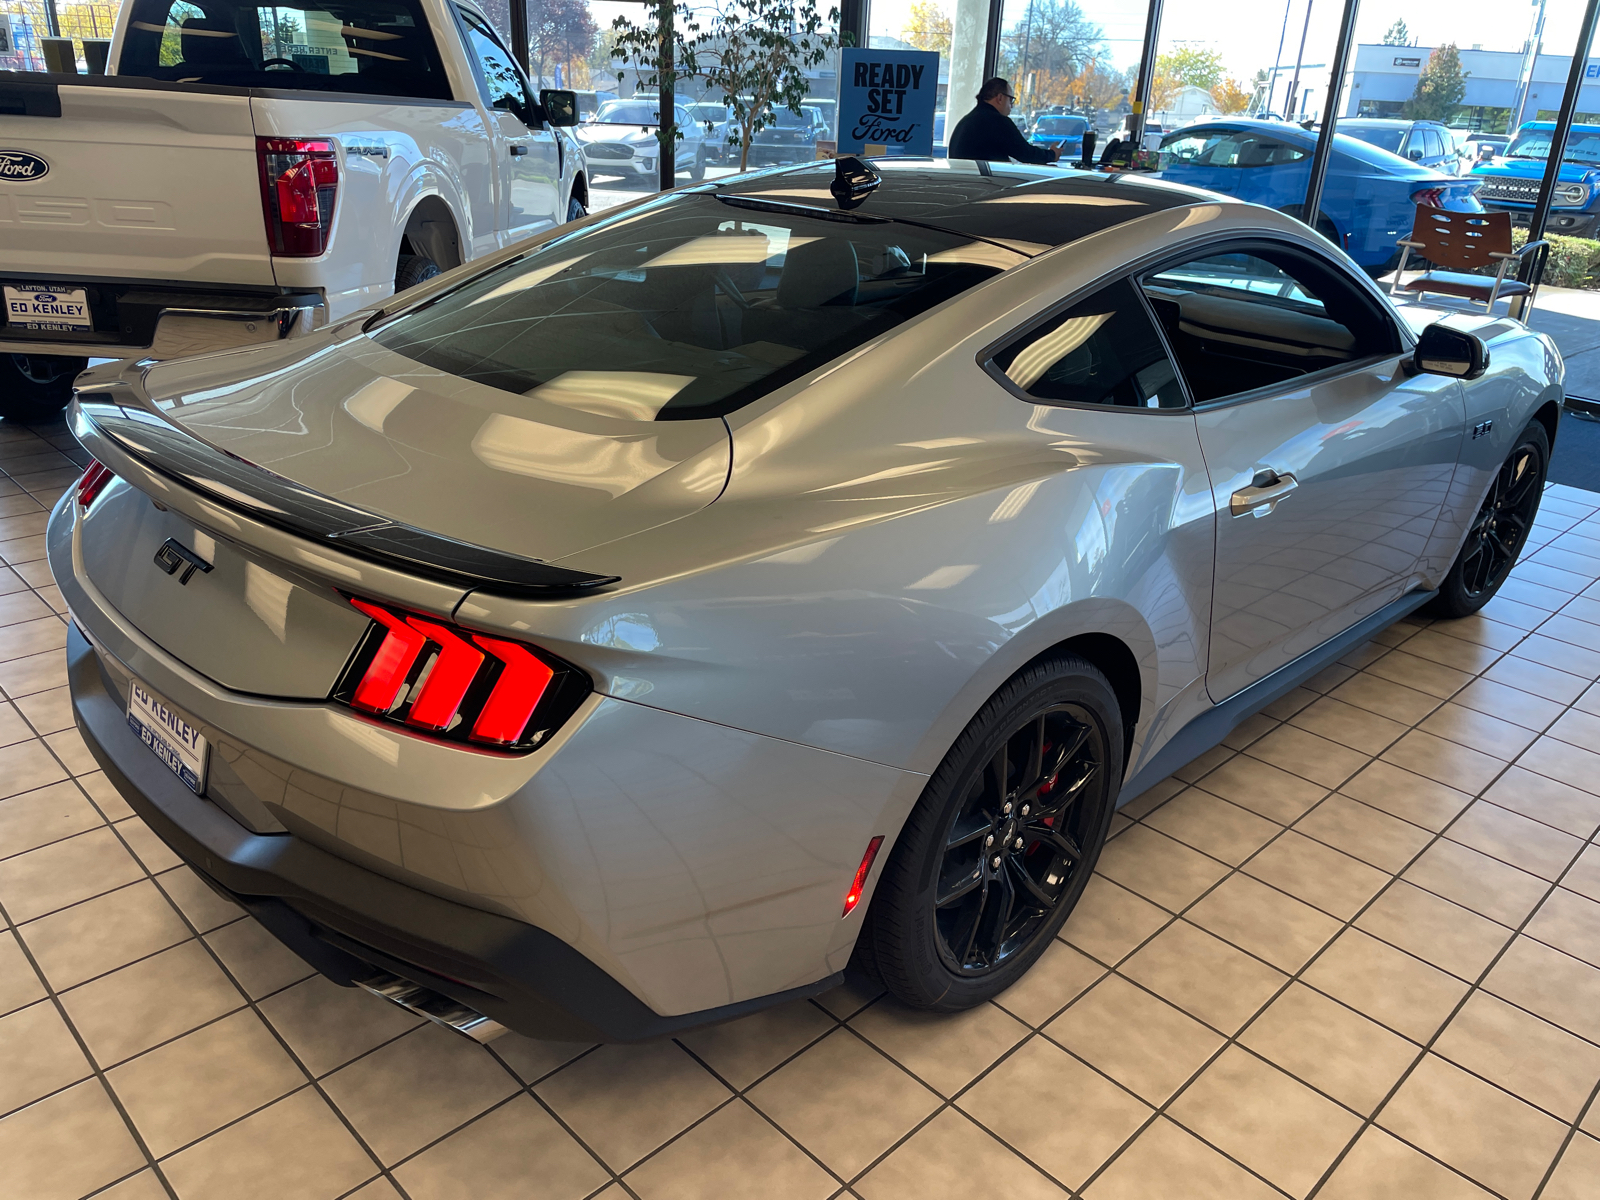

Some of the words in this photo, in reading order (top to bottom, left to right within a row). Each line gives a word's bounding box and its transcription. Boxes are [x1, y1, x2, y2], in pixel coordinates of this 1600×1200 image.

[854, 62, 924, 89] READY
[867, 88, 906, 114] SET
[852, 114, 915, 143] Ford
[1487, 184, 1540, 192] BRONC
[11, 302, 28, 313] ED
[32, 303, 83, 315] KENLEY
[38, 294, 53, 302] Ford
[40, 324, 73, 332] KENLEY
[154, 537, 215, 586] GT
[151, 698, 200, 750] KENLEY
[141, 726, 152, 745] ED
[152, 739, 183, 775] KENLEY
